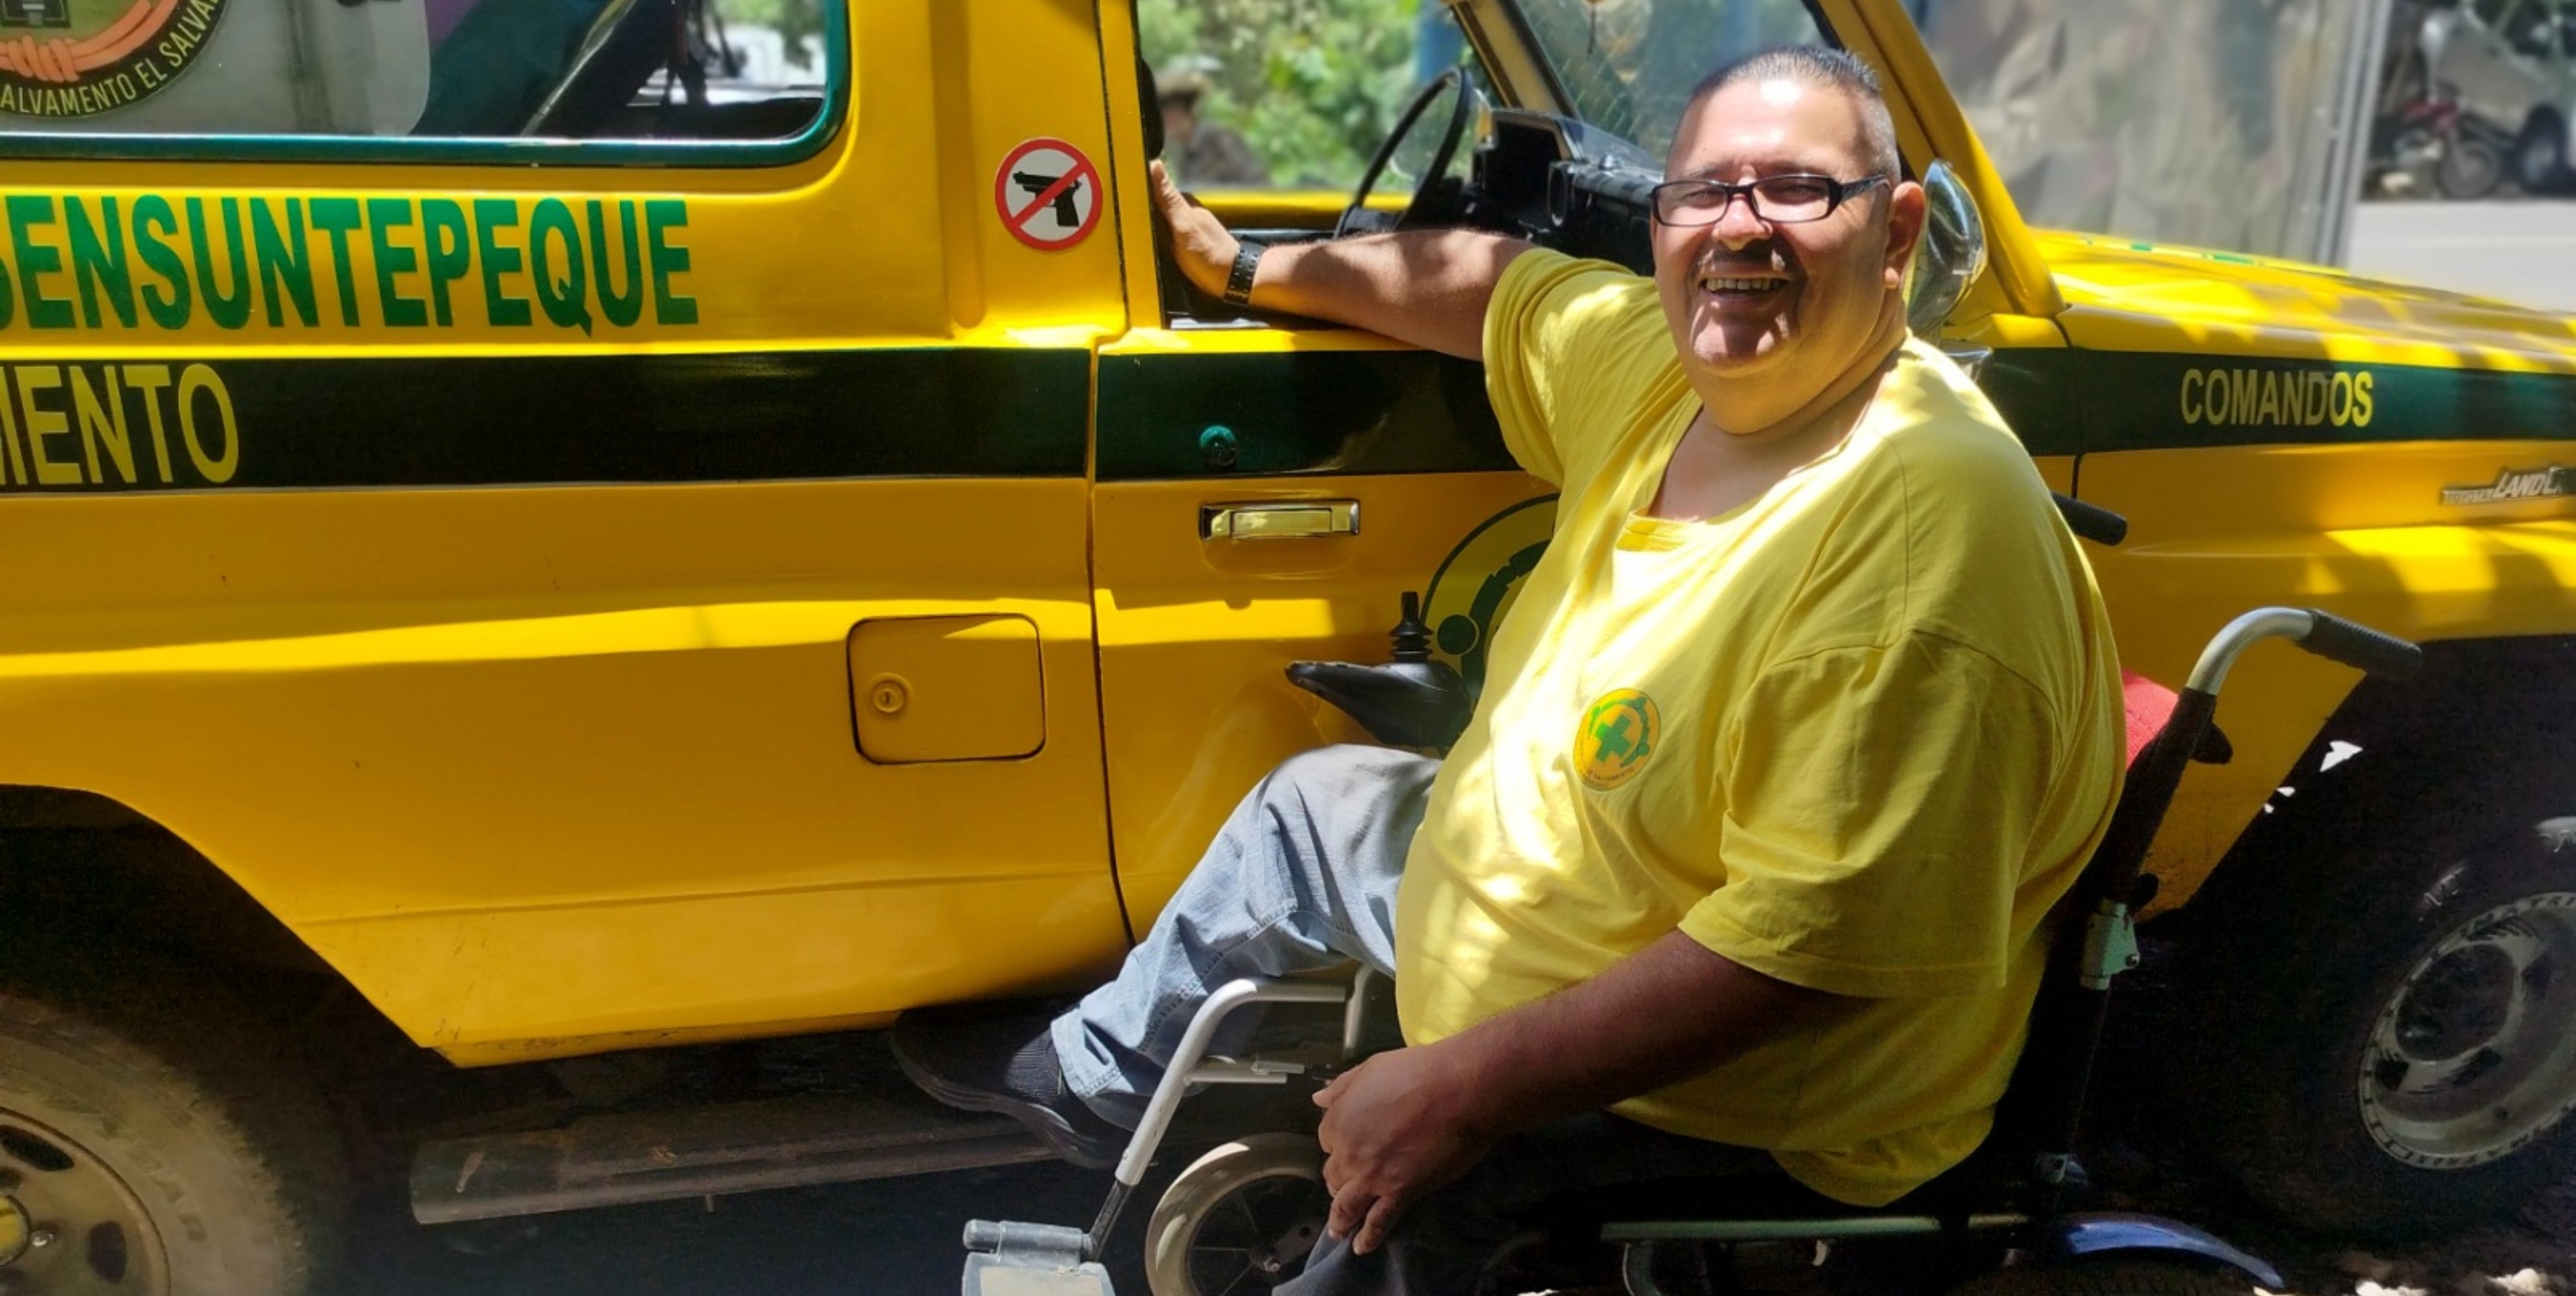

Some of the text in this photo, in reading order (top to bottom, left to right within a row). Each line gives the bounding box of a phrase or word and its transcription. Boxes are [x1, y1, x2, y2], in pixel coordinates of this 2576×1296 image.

[135, 58, 167, 88] EL
[159, 0, 218, 67] SALVA
[0, 194, 699, 337] ENSUNTEPEQUE
[2181, 369, 2374, 426] COMANDOS
